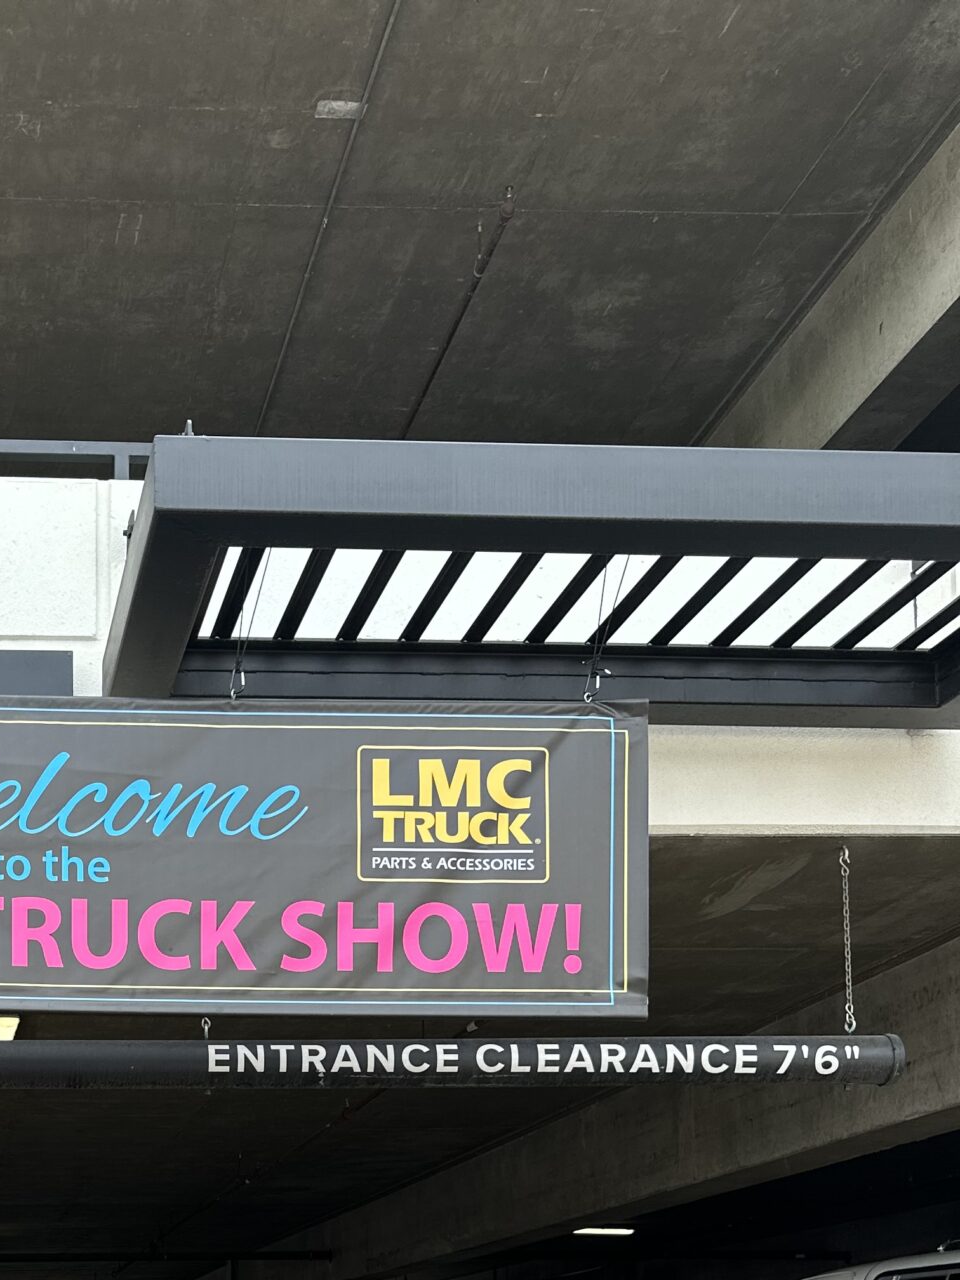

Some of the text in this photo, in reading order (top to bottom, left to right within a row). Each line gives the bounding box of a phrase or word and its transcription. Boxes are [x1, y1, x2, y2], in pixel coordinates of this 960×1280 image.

[372, 758, 532, 810] LMC
[43, 845, 111, 884] the
[371, 856, 535, 871] PARTS & ACCESSORIES
[279, 899, 584, 975] SHOW!
[207, 1043, 862, 1075] ENTRANCE CLEARANCE 7'6"
